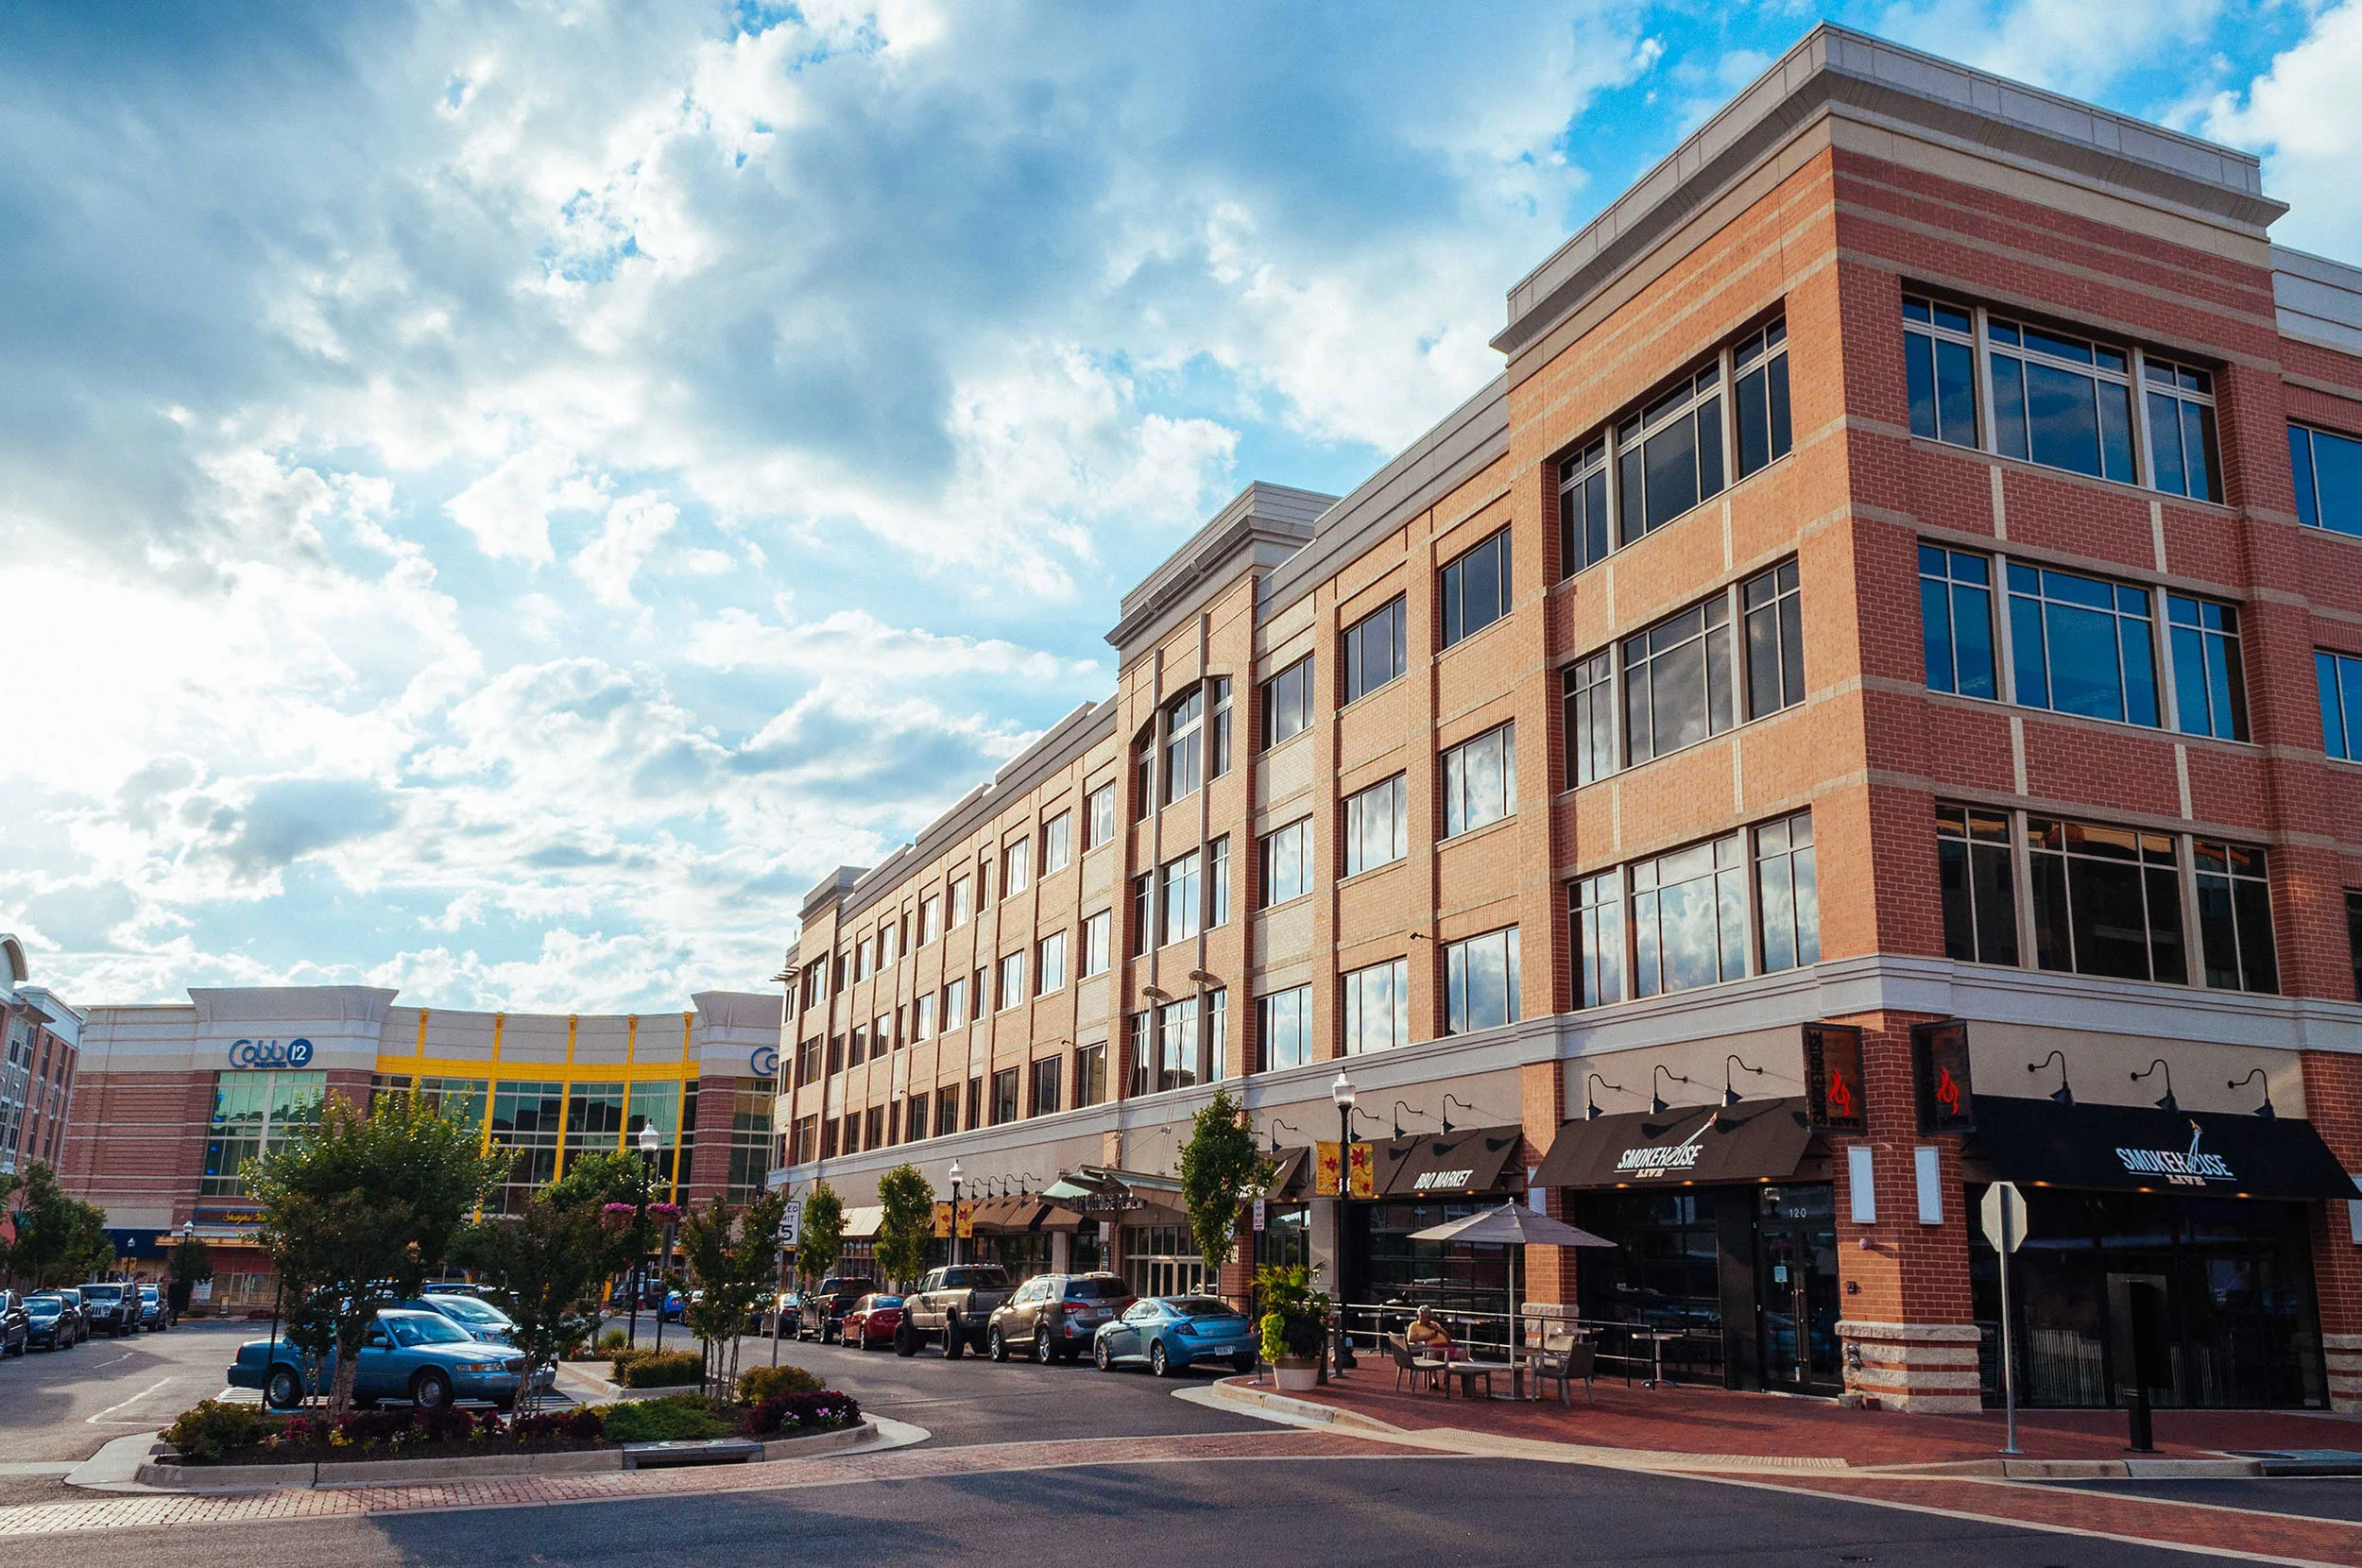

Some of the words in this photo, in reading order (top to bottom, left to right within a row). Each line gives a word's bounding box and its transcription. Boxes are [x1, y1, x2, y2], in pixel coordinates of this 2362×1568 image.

[229, 1039, 286, 1068] Cobb
[290, 1045, 307, 1061] 12
[750, 1046, 779, 1076] Co
[1617, 1144, 1703, 1169] SMOKEHOUSE
[2115, 1147, 2234, 1176] SMOKEHOUSE
[1412, 1171, 1437, 1189] BBQ
[1430, 1169, 1474, 1188] MARKET
[2165, 1173, 2207, 1186] LIVE
[1789, 1207, 1806, 1219] 120
